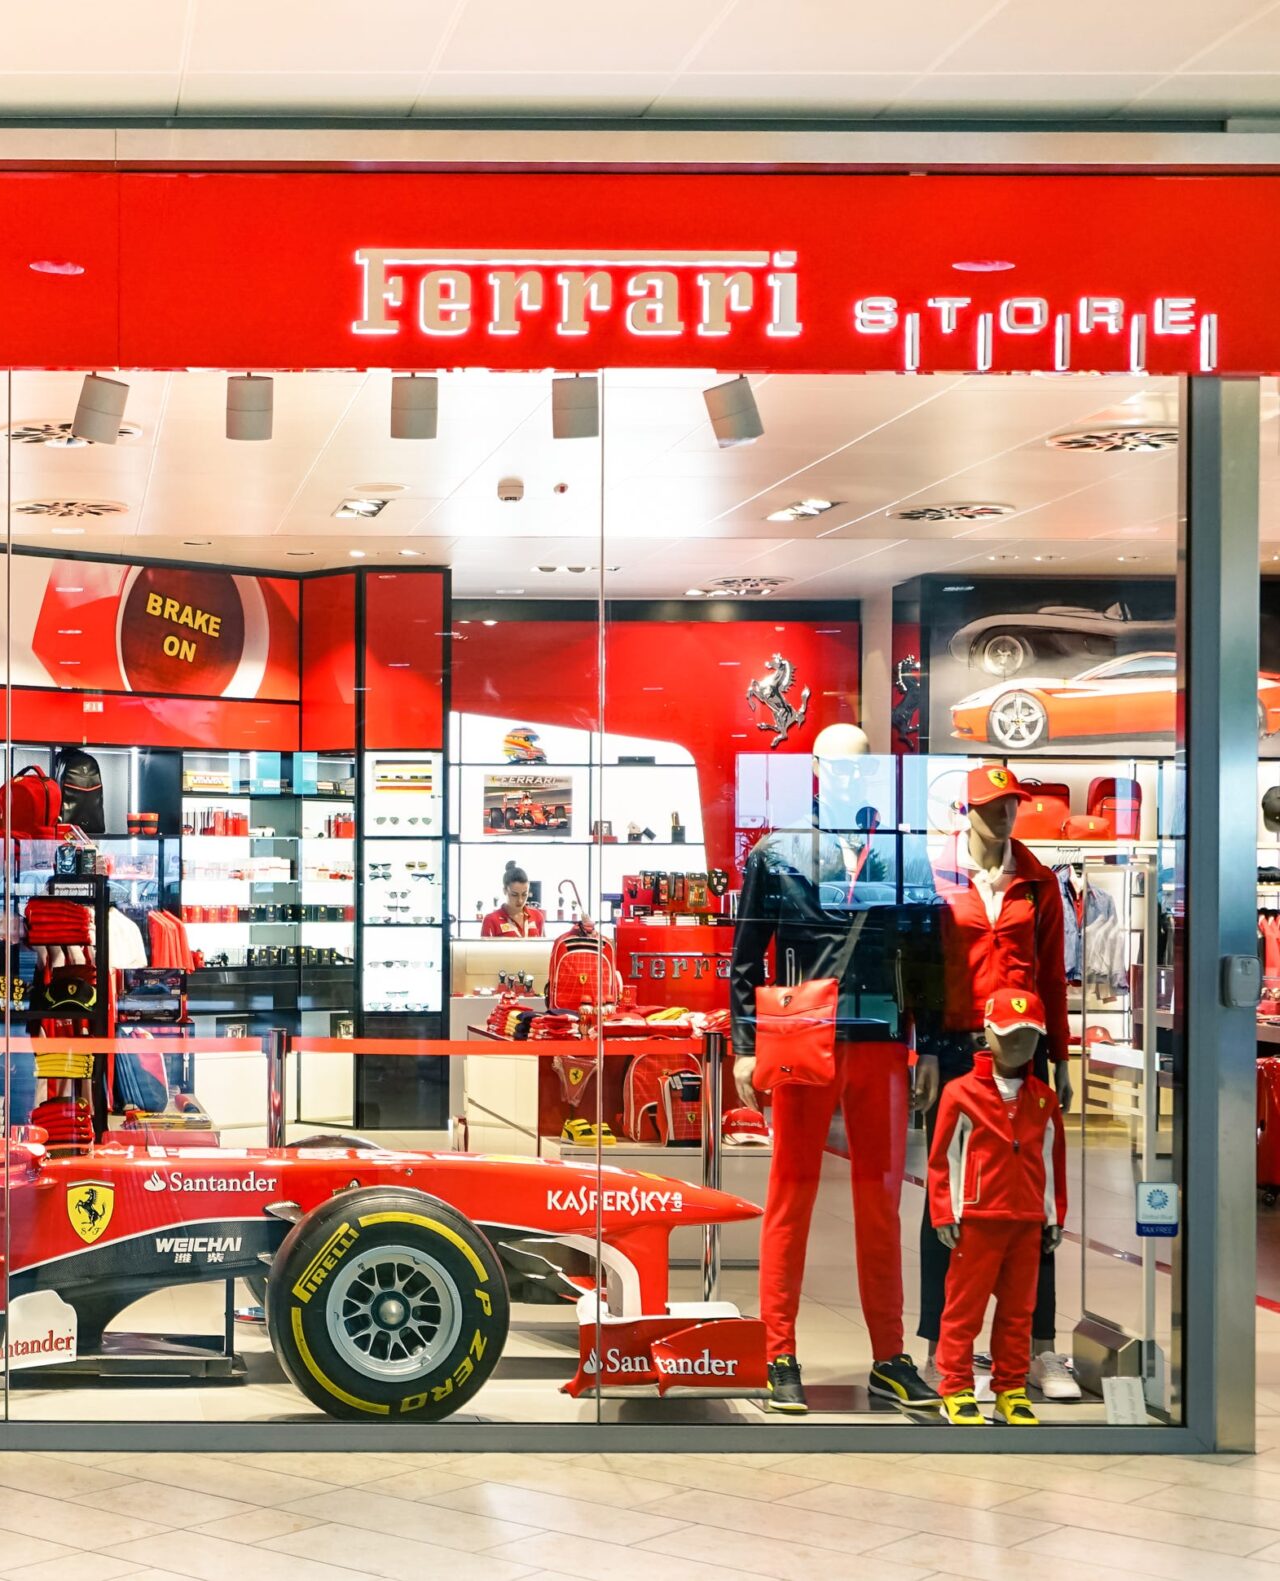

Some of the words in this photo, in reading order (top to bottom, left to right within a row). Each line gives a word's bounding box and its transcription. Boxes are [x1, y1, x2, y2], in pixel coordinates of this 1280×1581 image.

[352, 248, 803, 336] Ferrari
[854, 296, 1197, 334] STORE
[146, 592, 222, 638] BRAKE
[163, 636, 197, 663] ON
[501, 775, 558, 785] FERRARI
[170, 1171, 277, 1192] Santander
[546, 1185, 671, 1217] KASPERSKY
[155, 1237, 242, 1253] WEICHAI
[292, 1222, 360, 1304] PIRELLI
[474, 1288, 493, 1317] P
[400, 1328, 487, 1414] ZERO
